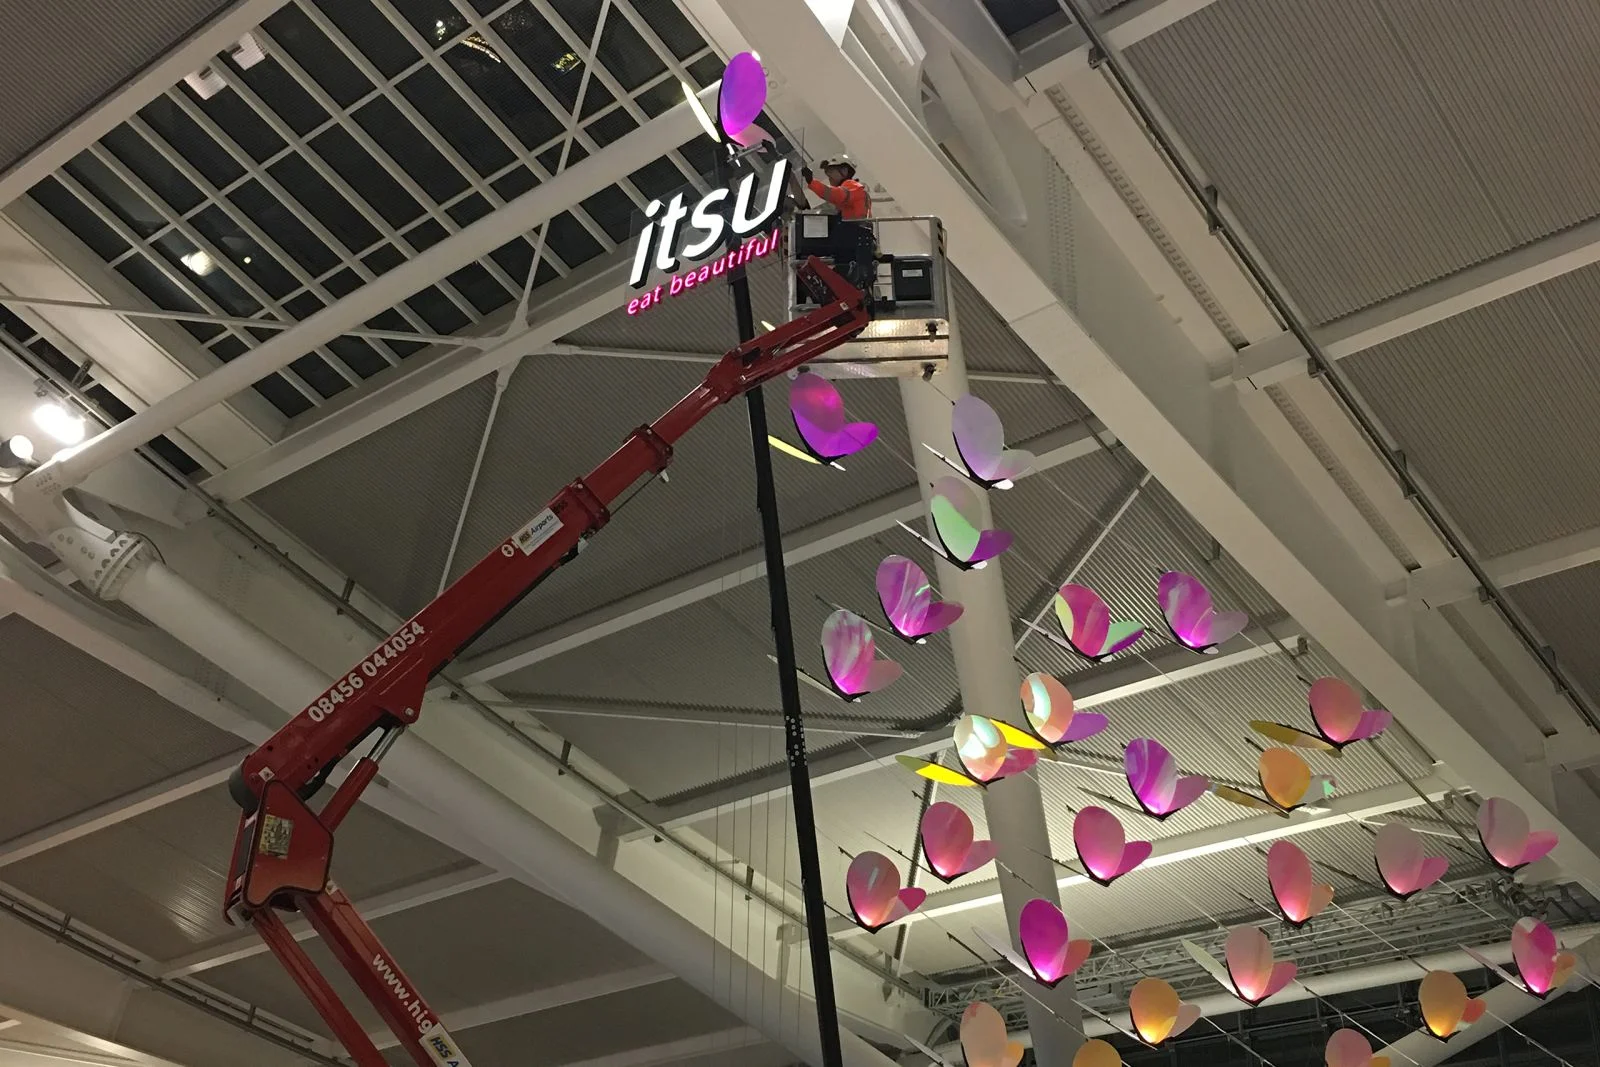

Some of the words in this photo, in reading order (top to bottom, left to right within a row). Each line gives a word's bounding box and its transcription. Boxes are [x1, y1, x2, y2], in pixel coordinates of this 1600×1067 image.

[629, 158, 789, 288] itsu
[627, 285, 662, 315] eat
[669, 228, 779, 296] beautiful
[530, 514, 554, 535] Airports
[308, 672, 364, 722] 08456
[361, 621, 425, 677] 044054
[430, 1036, 453, 1058] HSS
